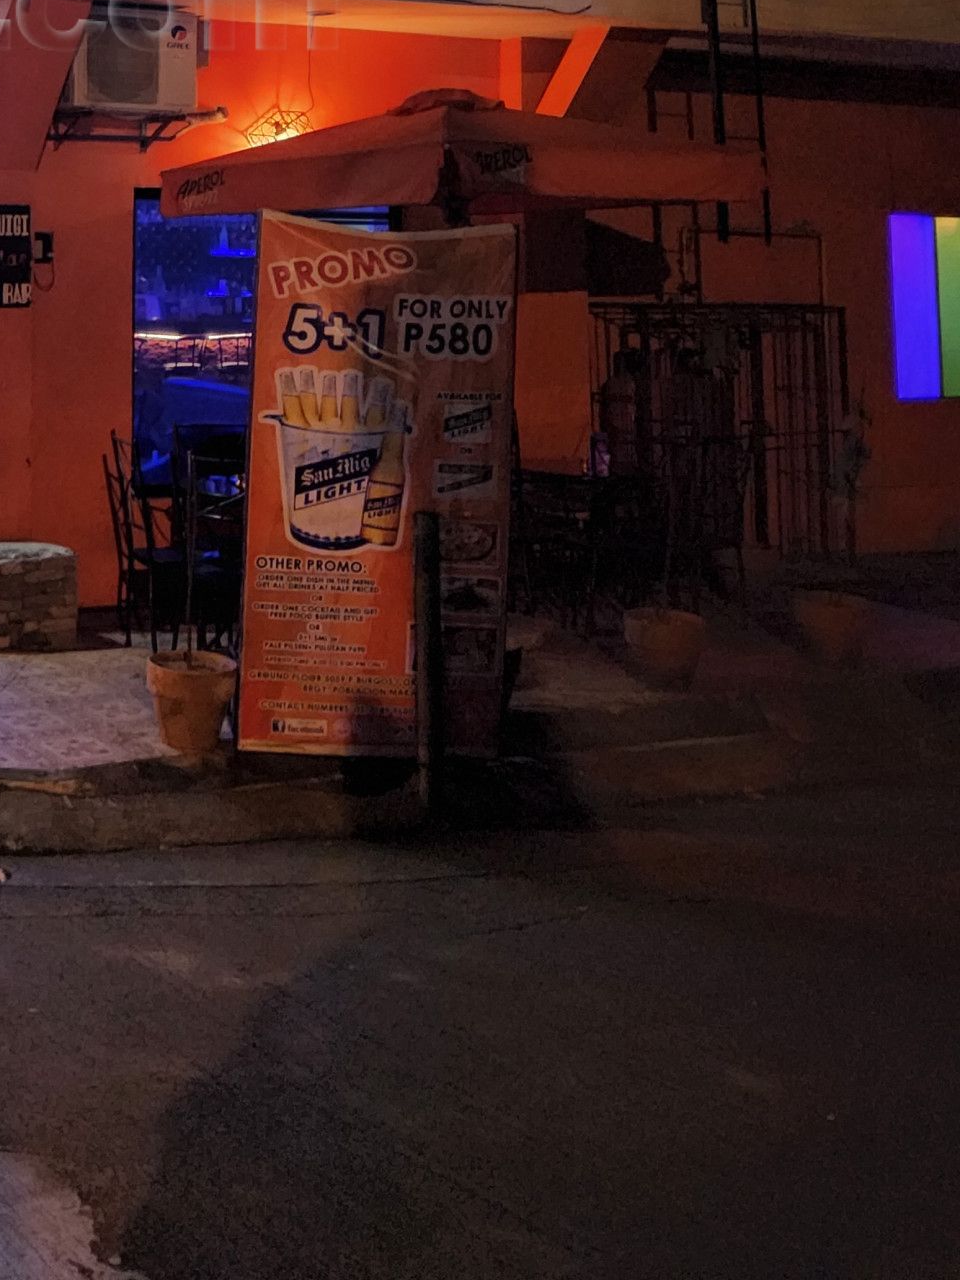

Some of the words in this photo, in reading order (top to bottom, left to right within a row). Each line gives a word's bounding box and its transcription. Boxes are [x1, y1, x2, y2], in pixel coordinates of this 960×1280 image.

[176, 169, 225, 200] APEROL
[271, 246, 414, 296] PROMO
[2, 282, 32, 305] BAR
[398, 298, 441, 319] FOR
[449, 299, 508, 320] ONLY
[283, 303, 387, 360] 5+1
[402, 322, 493, 357] P580
[437, 392, 483, 400] AVAILABLE
[300, 467, 333, 486] San
[334, 454, 371, 478] Mig
[304, 479, 366, 505] LIGHT
[256, 556, 302, 570] OTHER
[307, 559, 367, 574] PROMO:
